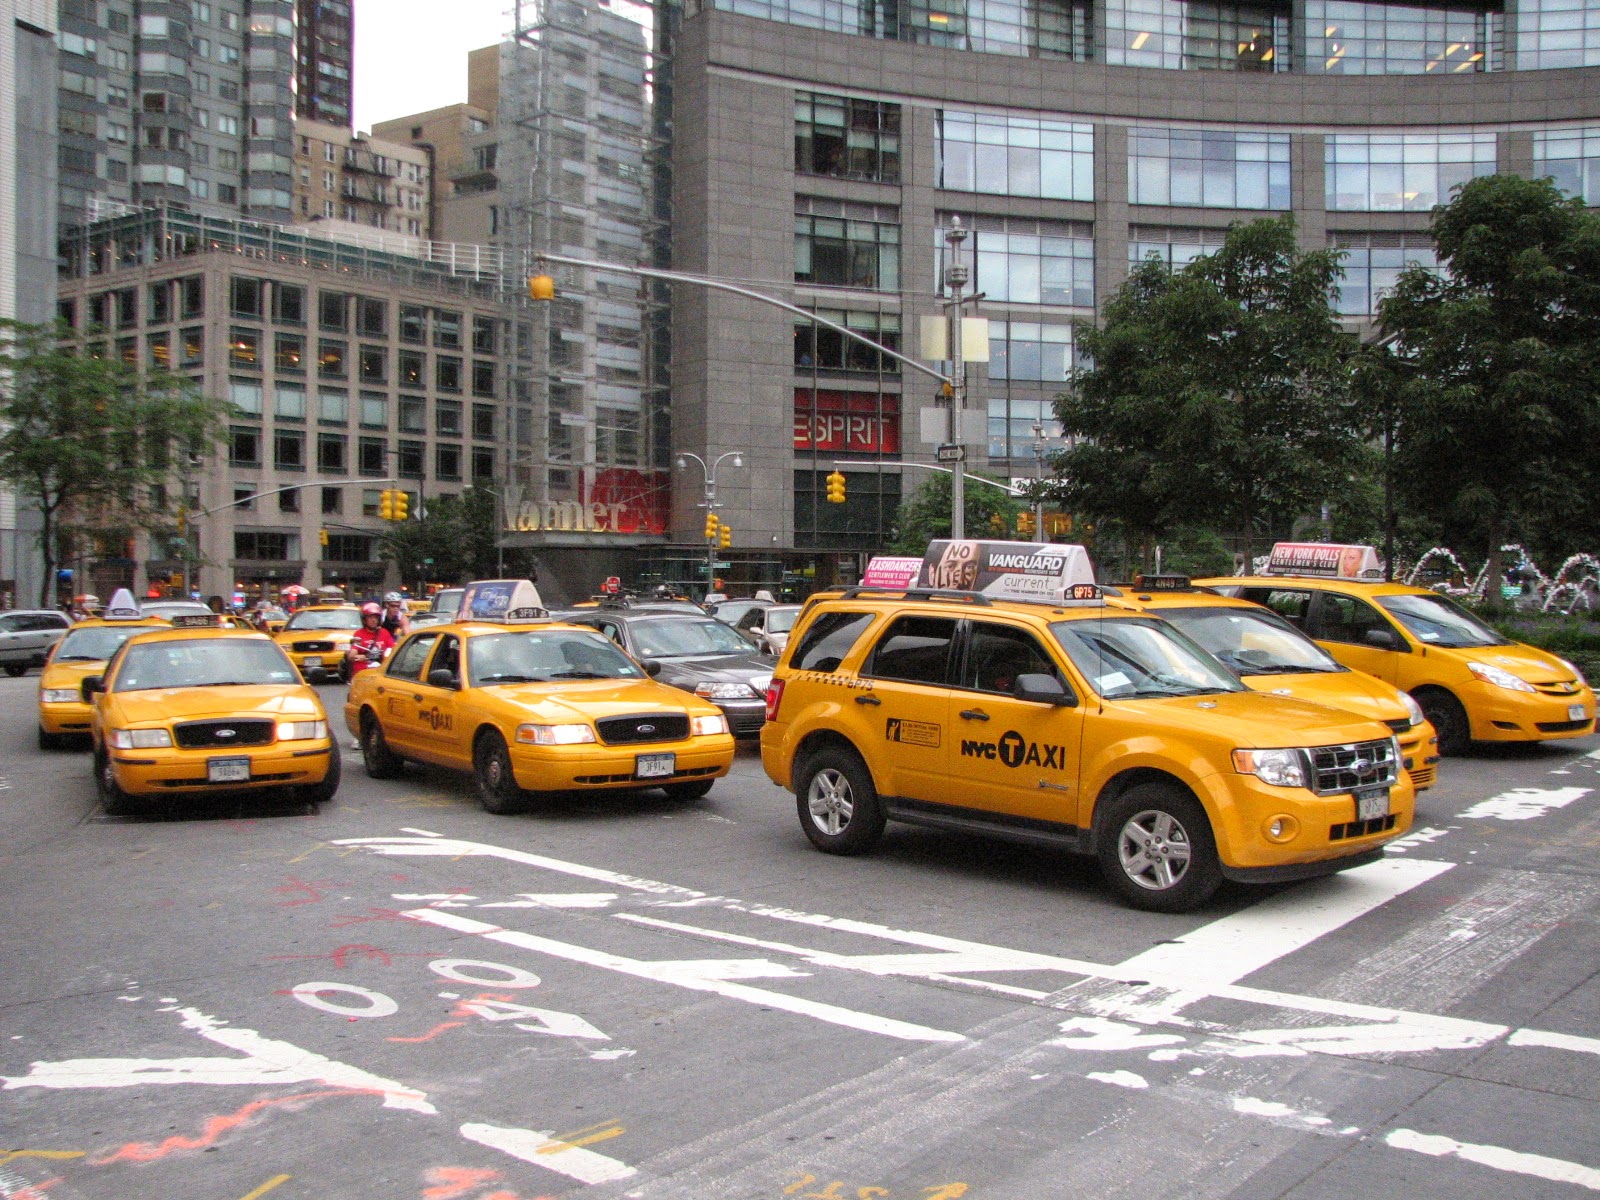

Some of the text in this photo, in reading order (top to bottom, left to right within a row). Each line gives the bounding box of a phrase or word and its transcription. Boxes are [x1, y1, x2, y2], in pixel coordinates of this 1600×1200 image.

[794, 414, 889, 445] ESPRIT
[946, 543, 971, 560] NO
[1273, 547, 1341, 561] NEW YORK DOLLS
[989, 553, 1063, 570] VANGUARD
[1271, 558, 1317, 567] GENTLEMEN'S
[1074, 586, 1093, 599] 6P75
[519, 609, 538, 618] 3F91
[961, 730, 1066, 770] NYC TAXI
